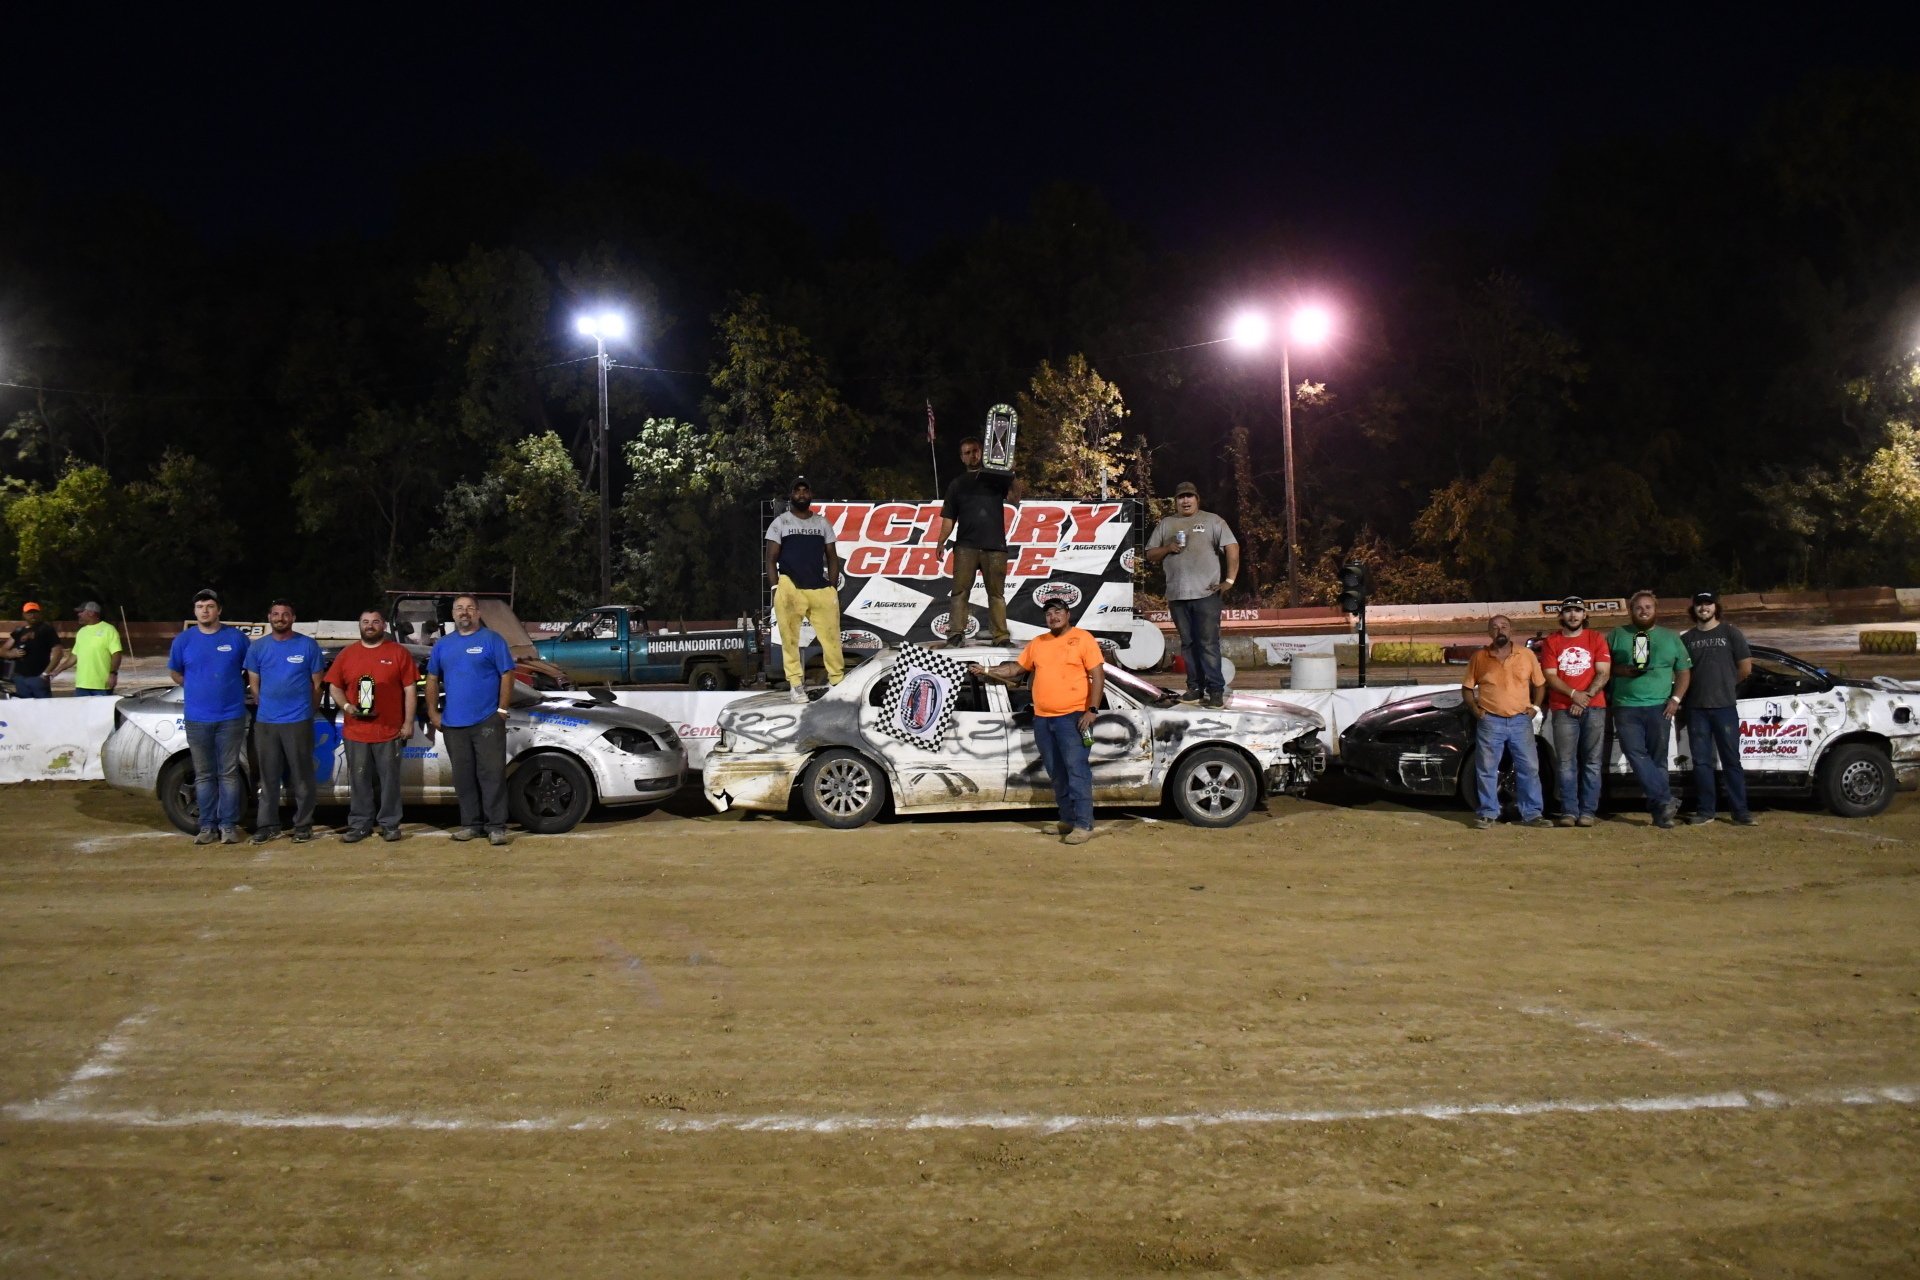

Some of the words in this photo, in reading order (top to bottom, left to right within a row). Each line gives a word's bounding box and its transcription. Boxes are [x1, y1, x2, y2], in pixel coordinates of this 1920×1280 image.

[809, 504, 1120, 543] VICTRY
[846, 547, 1057, 577] CIRE
[236, 626, 264, 636] CB
[16, 743, 31, 751] INC
